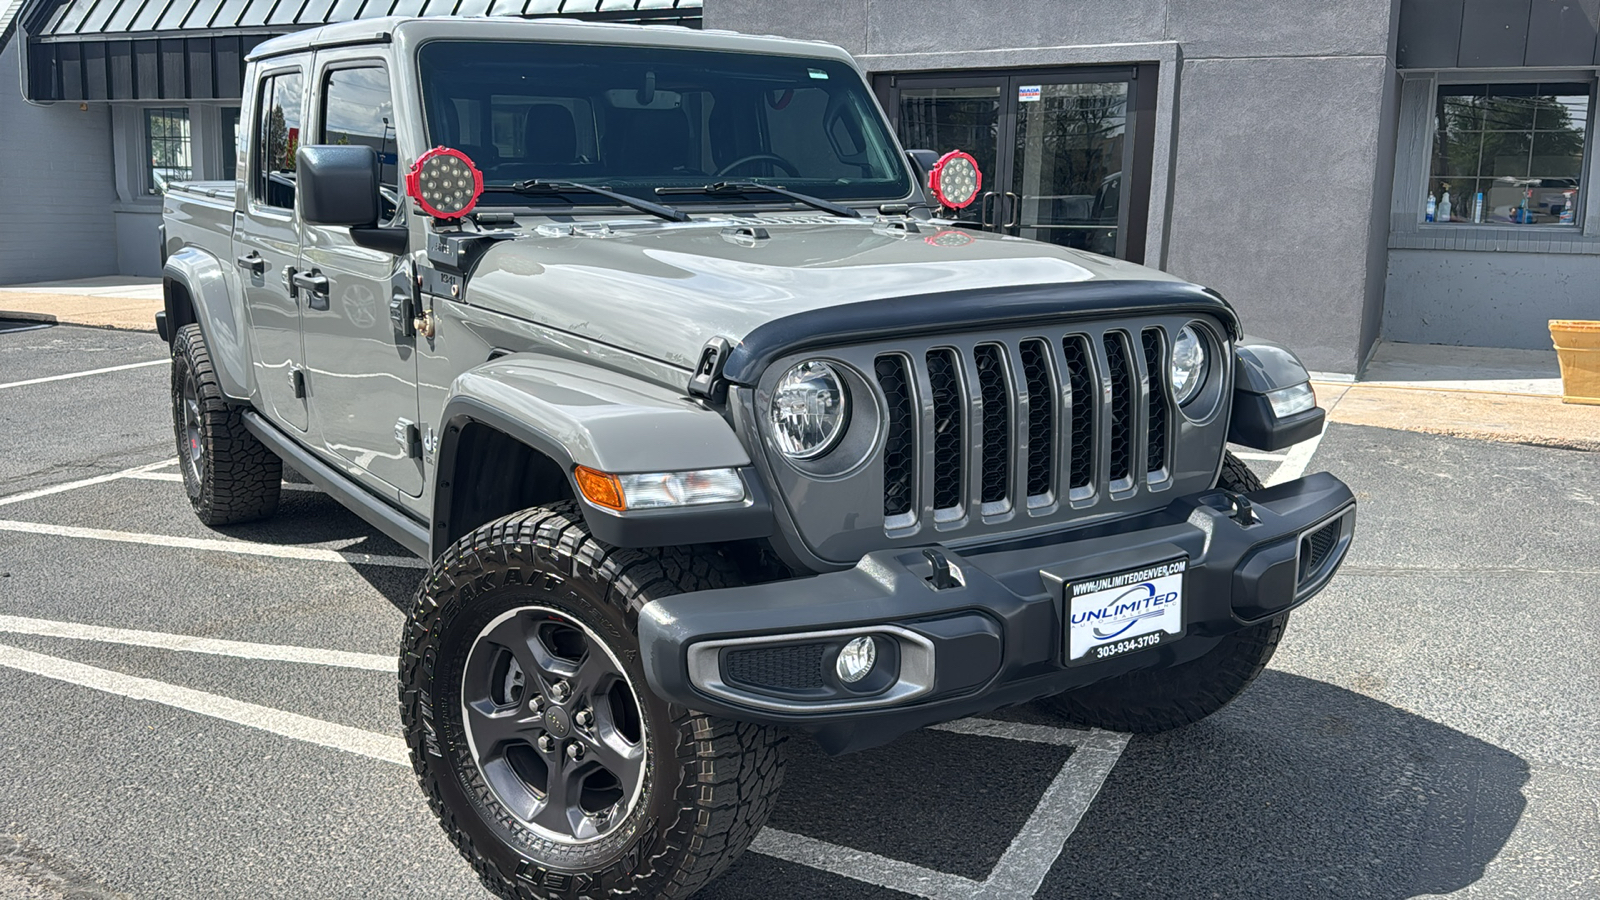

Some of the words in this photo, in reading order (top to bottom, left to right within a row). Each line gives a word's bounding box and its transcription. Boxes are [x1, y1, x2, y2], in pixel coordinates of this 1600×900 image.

[503, 566, 565, 590] A/T
[1071, 592, 1178, 624] UNLIMITED
[1071, 619, 1104, 629] AUTO
[1113, 608, 1150, 621] SALES
[1097, 633, 1160, 659] 303-934-3705
